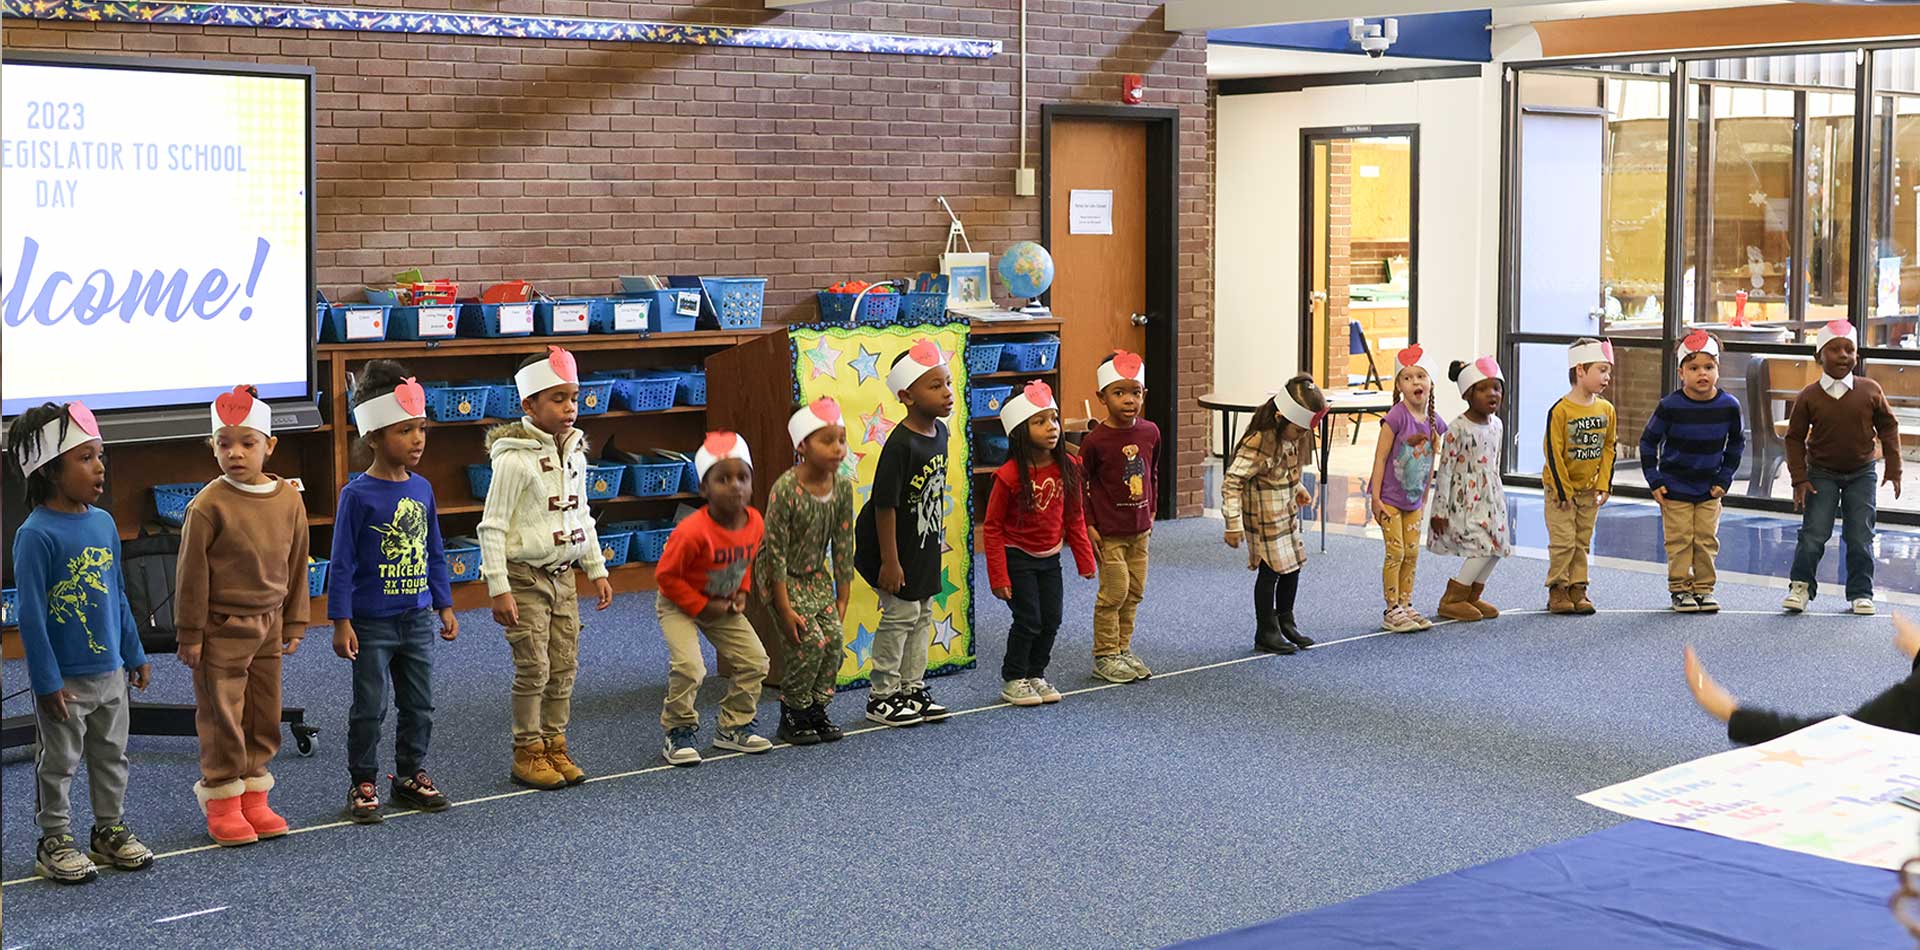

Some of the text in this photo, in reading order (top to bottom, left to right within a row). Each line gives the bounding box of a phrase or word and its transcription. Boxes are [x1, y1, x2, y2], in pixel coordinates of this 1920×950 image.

[27, 101, 84, 130] 2023
[2, 140, 247, 172] EGISLATOR TO SCHOOL
[36, 179, 78, 208] DAY
[3, 236, 270, 327] lcome!
[1578, 417, 1600, 429] NEXT
[1583, 434, 1598, 444] BIG
[1577, 448, 1600, 459] THING
[714, 543, 755, 564] DIRT
[384, 580, 397, 589] 3X
[1601, 780, 1716, 807] Welcome
